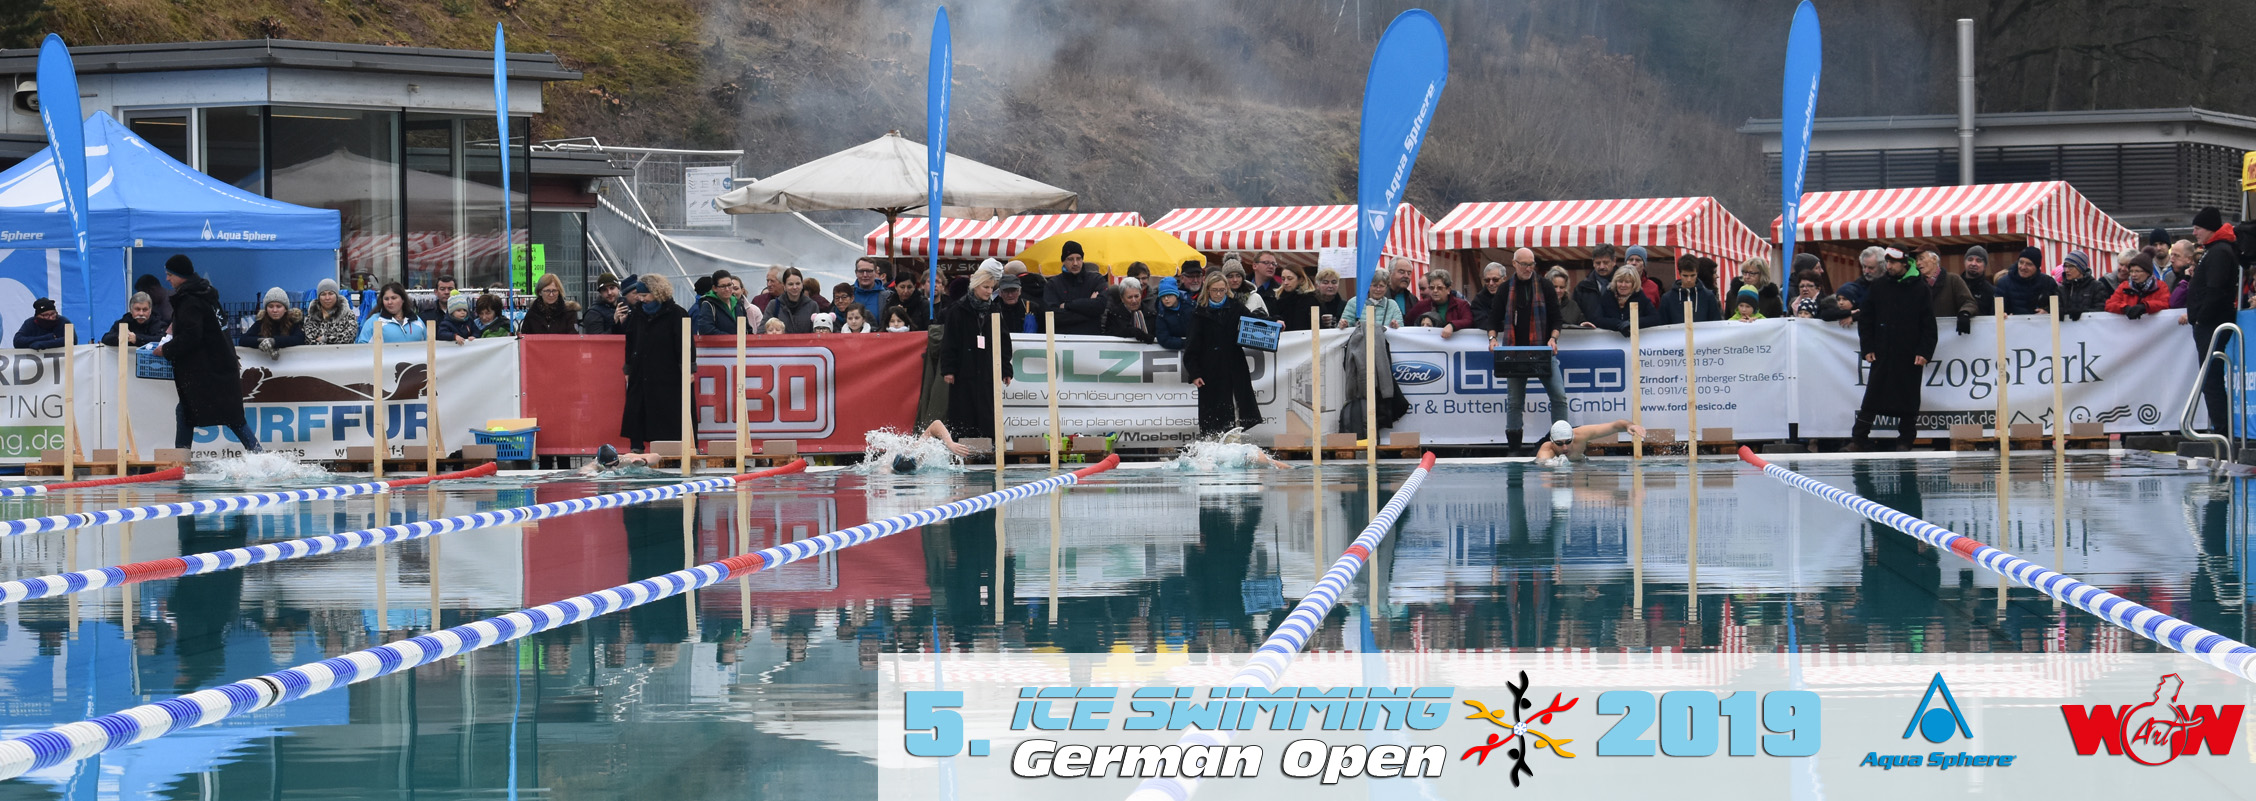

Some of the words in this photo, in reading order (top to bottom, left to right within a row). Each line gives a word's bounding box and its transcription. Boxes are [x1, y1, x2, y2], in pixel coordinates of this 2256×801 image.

[1793, 146, 1806, 199] Aqua
[1802, 75, 1818, 146] Sphere
[1385, 153, 1408, 208] Aqua
[1404, 80, 1436, 154] Sphere
[0, 231, 44, 242] Sphere
[216, 230, 241, 242] Aqua
[242, 230, 277, 242] Sphere
[1639, 348, 1684, 358] Nürnberg
[1693, 347, 1721, 357] eyher
[1723, 345, 1755, 355] Straße
[1756, 345, 1772, 354] 152
[1460, 350, 1622, 389] bco
[1639, 360, 1656, 368] Tel.
[1702, 358, 1724, 367] 87-0
[1393, 364, 1432, 381] Ford
[1854, 341, 2104, 400] HzogPark
[1639, 375, 1679, 384] Zirndorf
[1685, 374, 1737, 384] rnberger
[1738, 372, 1770, 382] Straße
[1771, 372, 1785, 381] 65
[693, 364, 818, 424] ABO
[1156, 392, 1187, 400] vom
[1640, 387, 1656, 396] Tel.
[1657, 386, 1688, 395] 0911/6
[1697, 385, 1712, 395] 00
[1713, 385, 1731, 394] 9-0
[1425, 399, 1438, 415] &
[1444, 398, 1553, 415] Buttenus
[1569, 397, 1627, 413] GmbH
[1640, 401, 1738, 413] www.fordesico.de
[1043, 416, 1083, 427] oline
[1086, 417, 1132, 429] planen
[1136, 417, 1167, 426] und
[222, 448, 241, 459] the
